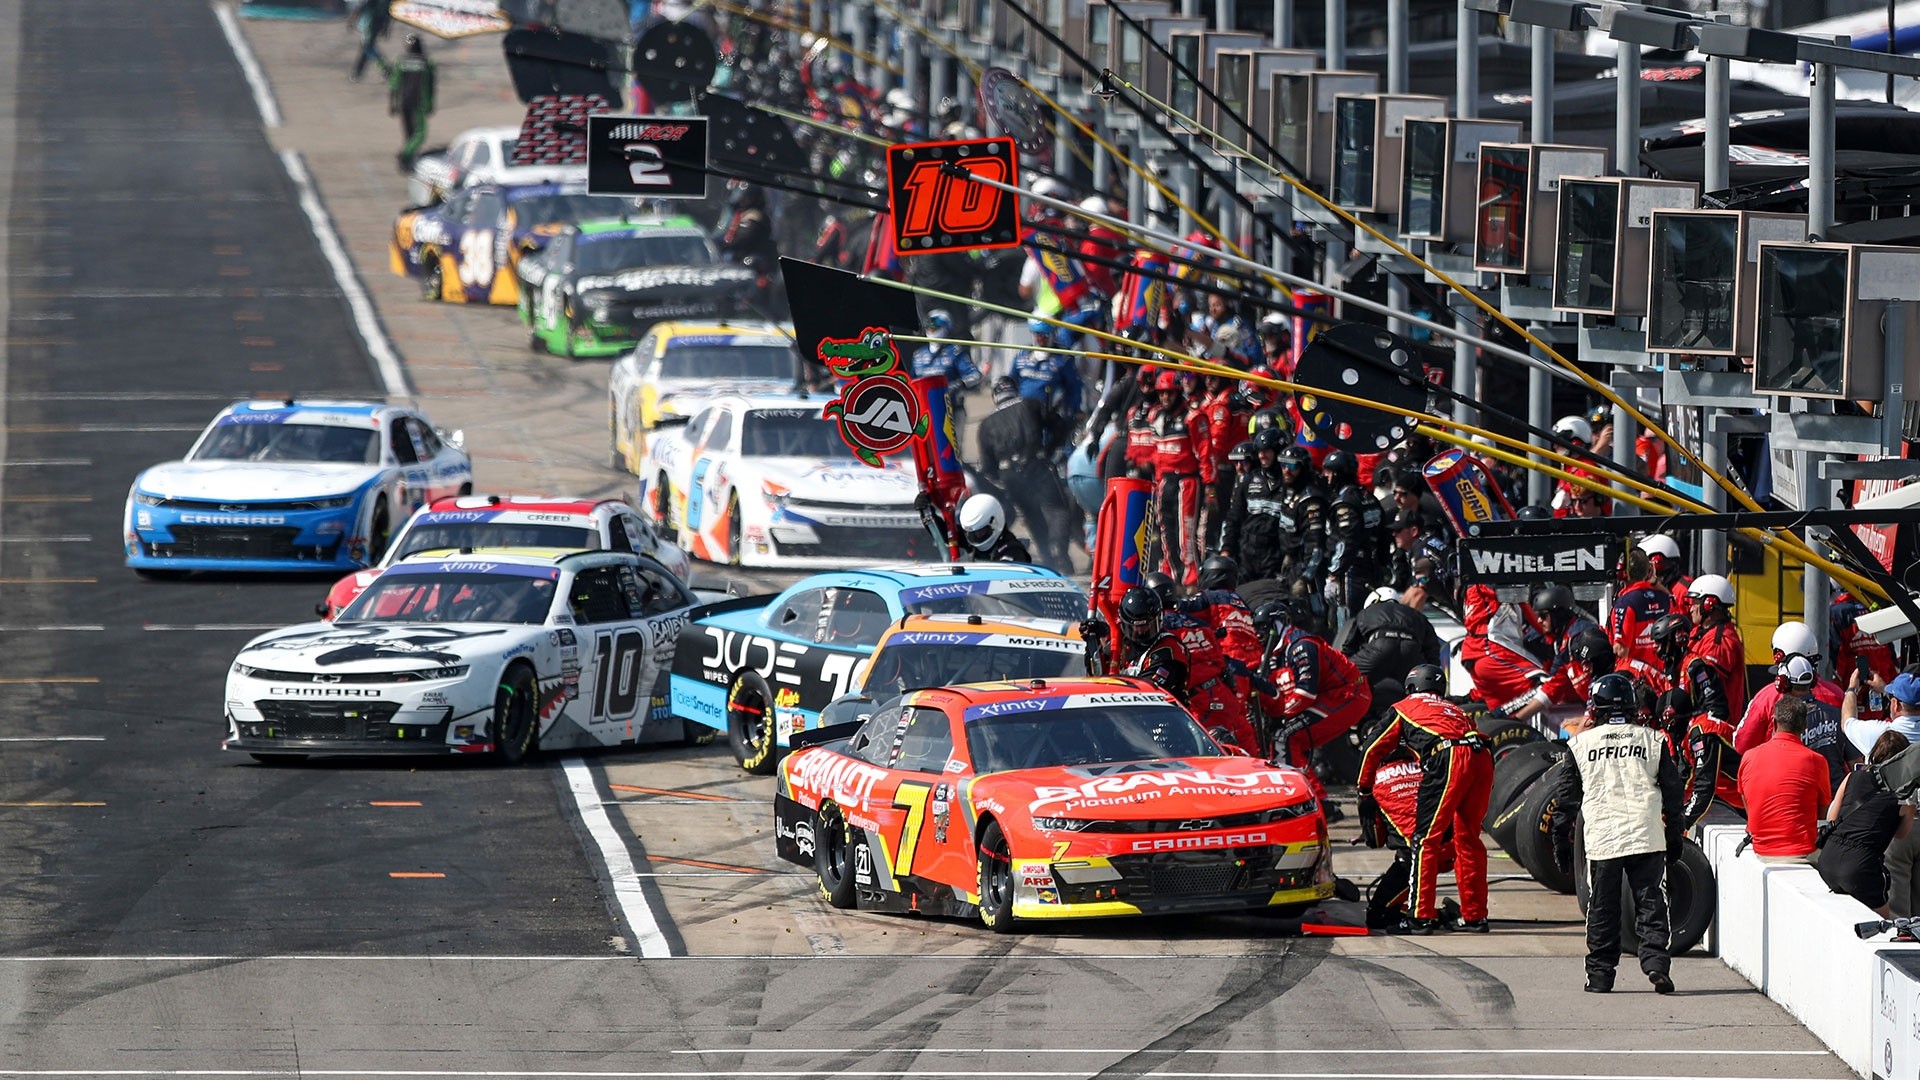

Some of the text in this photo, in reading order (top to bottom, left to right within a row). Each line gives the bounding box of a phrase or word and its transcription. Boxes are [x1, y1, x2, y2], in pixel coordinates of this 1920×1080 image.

[623, 143, 672, 186] 2
[901, 157, 1007, 237] 10
[843, 396, 914, 435] JA
[427, 511, 486, 523] xfinity
[527, 513, 571, 523] CREED
[439, 561, 498, 573] xfinity
[1469, 545, 1606, 574] WHELEN
[914, 583, 974, 599] xfinity
[1008, 580, 1066, 590] ALFREDO
[901, 632, 969, 645] xfinity
[1008, 637, 1084, 651] MOFFITT
[589, 625, 646, 725] 10
[703, 670, 729, 684] WIPES
[1435, 673, 1442, 681] 7
[270, 687, 381, 697] CAMARO
[979, 698, 1049, 716] xfinity
[1493, 728, 1531, 747] EAGLE
[1588, 744, 1649, 762] OFFICIAL
[789, 748, 889, 813] BRANDT
[1028, 771, 1298, 813] BRANDT
[1064, 784, 1298, 812] Platinum Anniversary
[892, 779, 934, 878] 7
[1132, 832, 1267, 851] CAMARO
[1052, 841, 1072, 862] 7
[1022, 864, 1047, 875] SIMPSON
[1023, 877, 1054, 886] ARP
